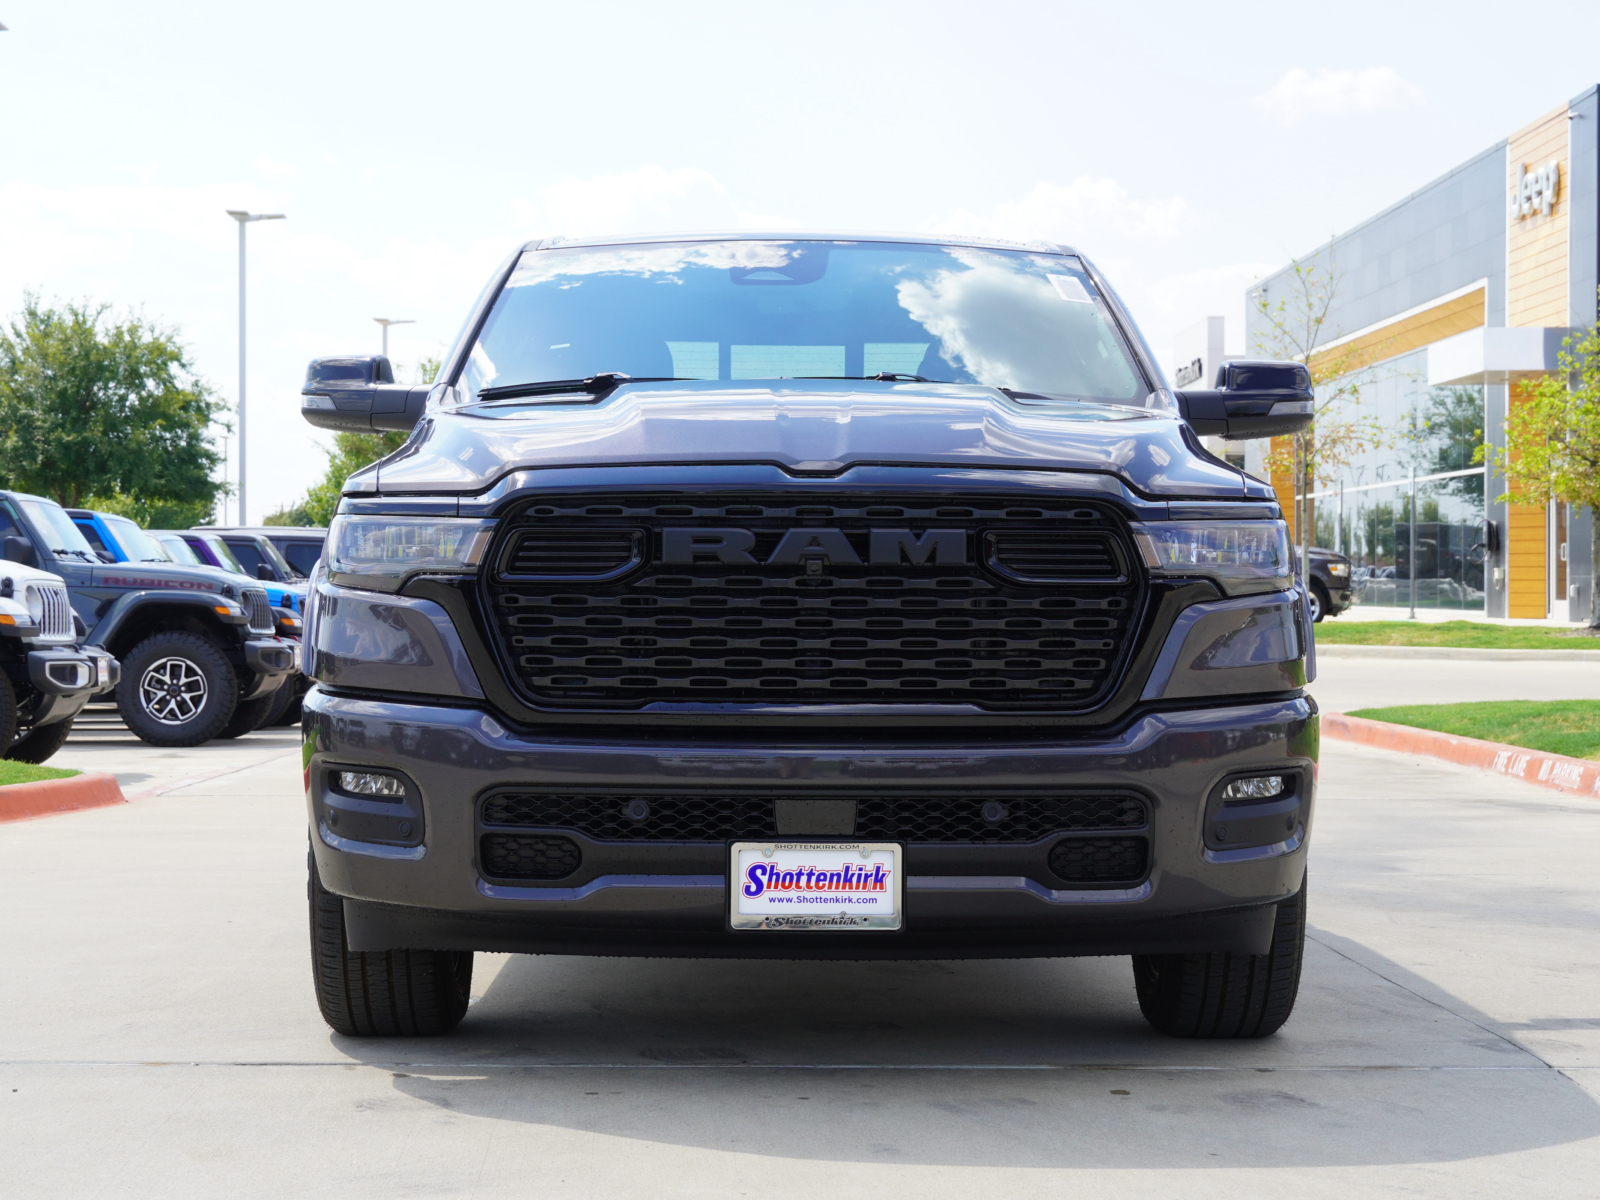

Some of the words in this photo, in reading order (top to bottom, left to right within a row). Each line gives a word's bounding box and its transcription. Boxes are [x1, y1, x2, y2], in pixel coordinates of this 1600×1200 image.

[1511, 160, 1559, 220] Jeep
[662, 528, 967, 566] RAM
[103, 576, 214, 590] RUBICON
[743, 862, 889, 898] Shottenkirk
[768, 895, 878, 904] www.Shottenkirk.com
[771, 916, 859, 926] Shottenkirk
